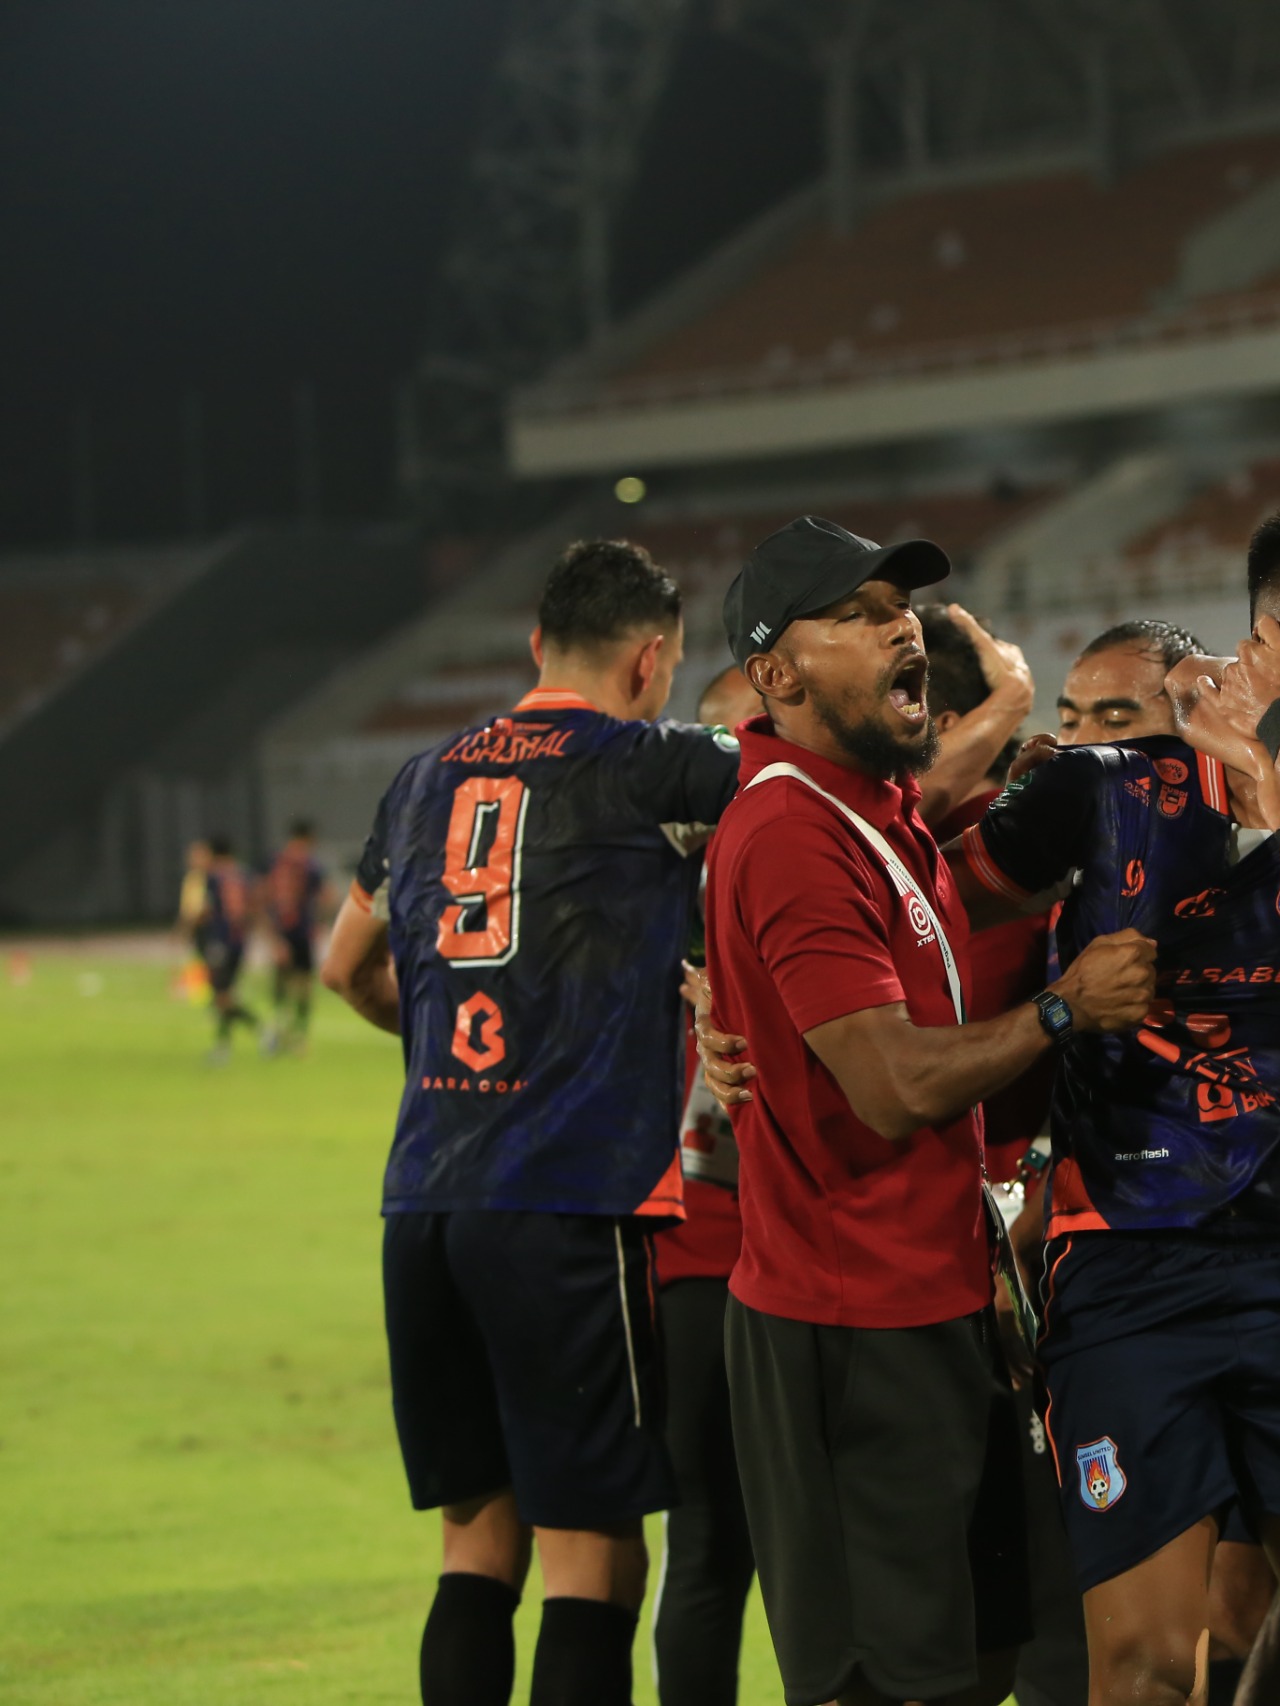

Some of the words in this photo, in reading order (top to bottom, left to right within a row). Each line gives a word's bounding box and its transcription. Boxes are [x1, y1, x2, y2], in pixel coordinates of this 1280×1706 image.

[435, 774, 531, 968] 9
[916, 933, 936, 947] XTEN
[422, 1076, 528, 1093] BARACOA
[1114, 1147, 1169, 1161] aeroflash
